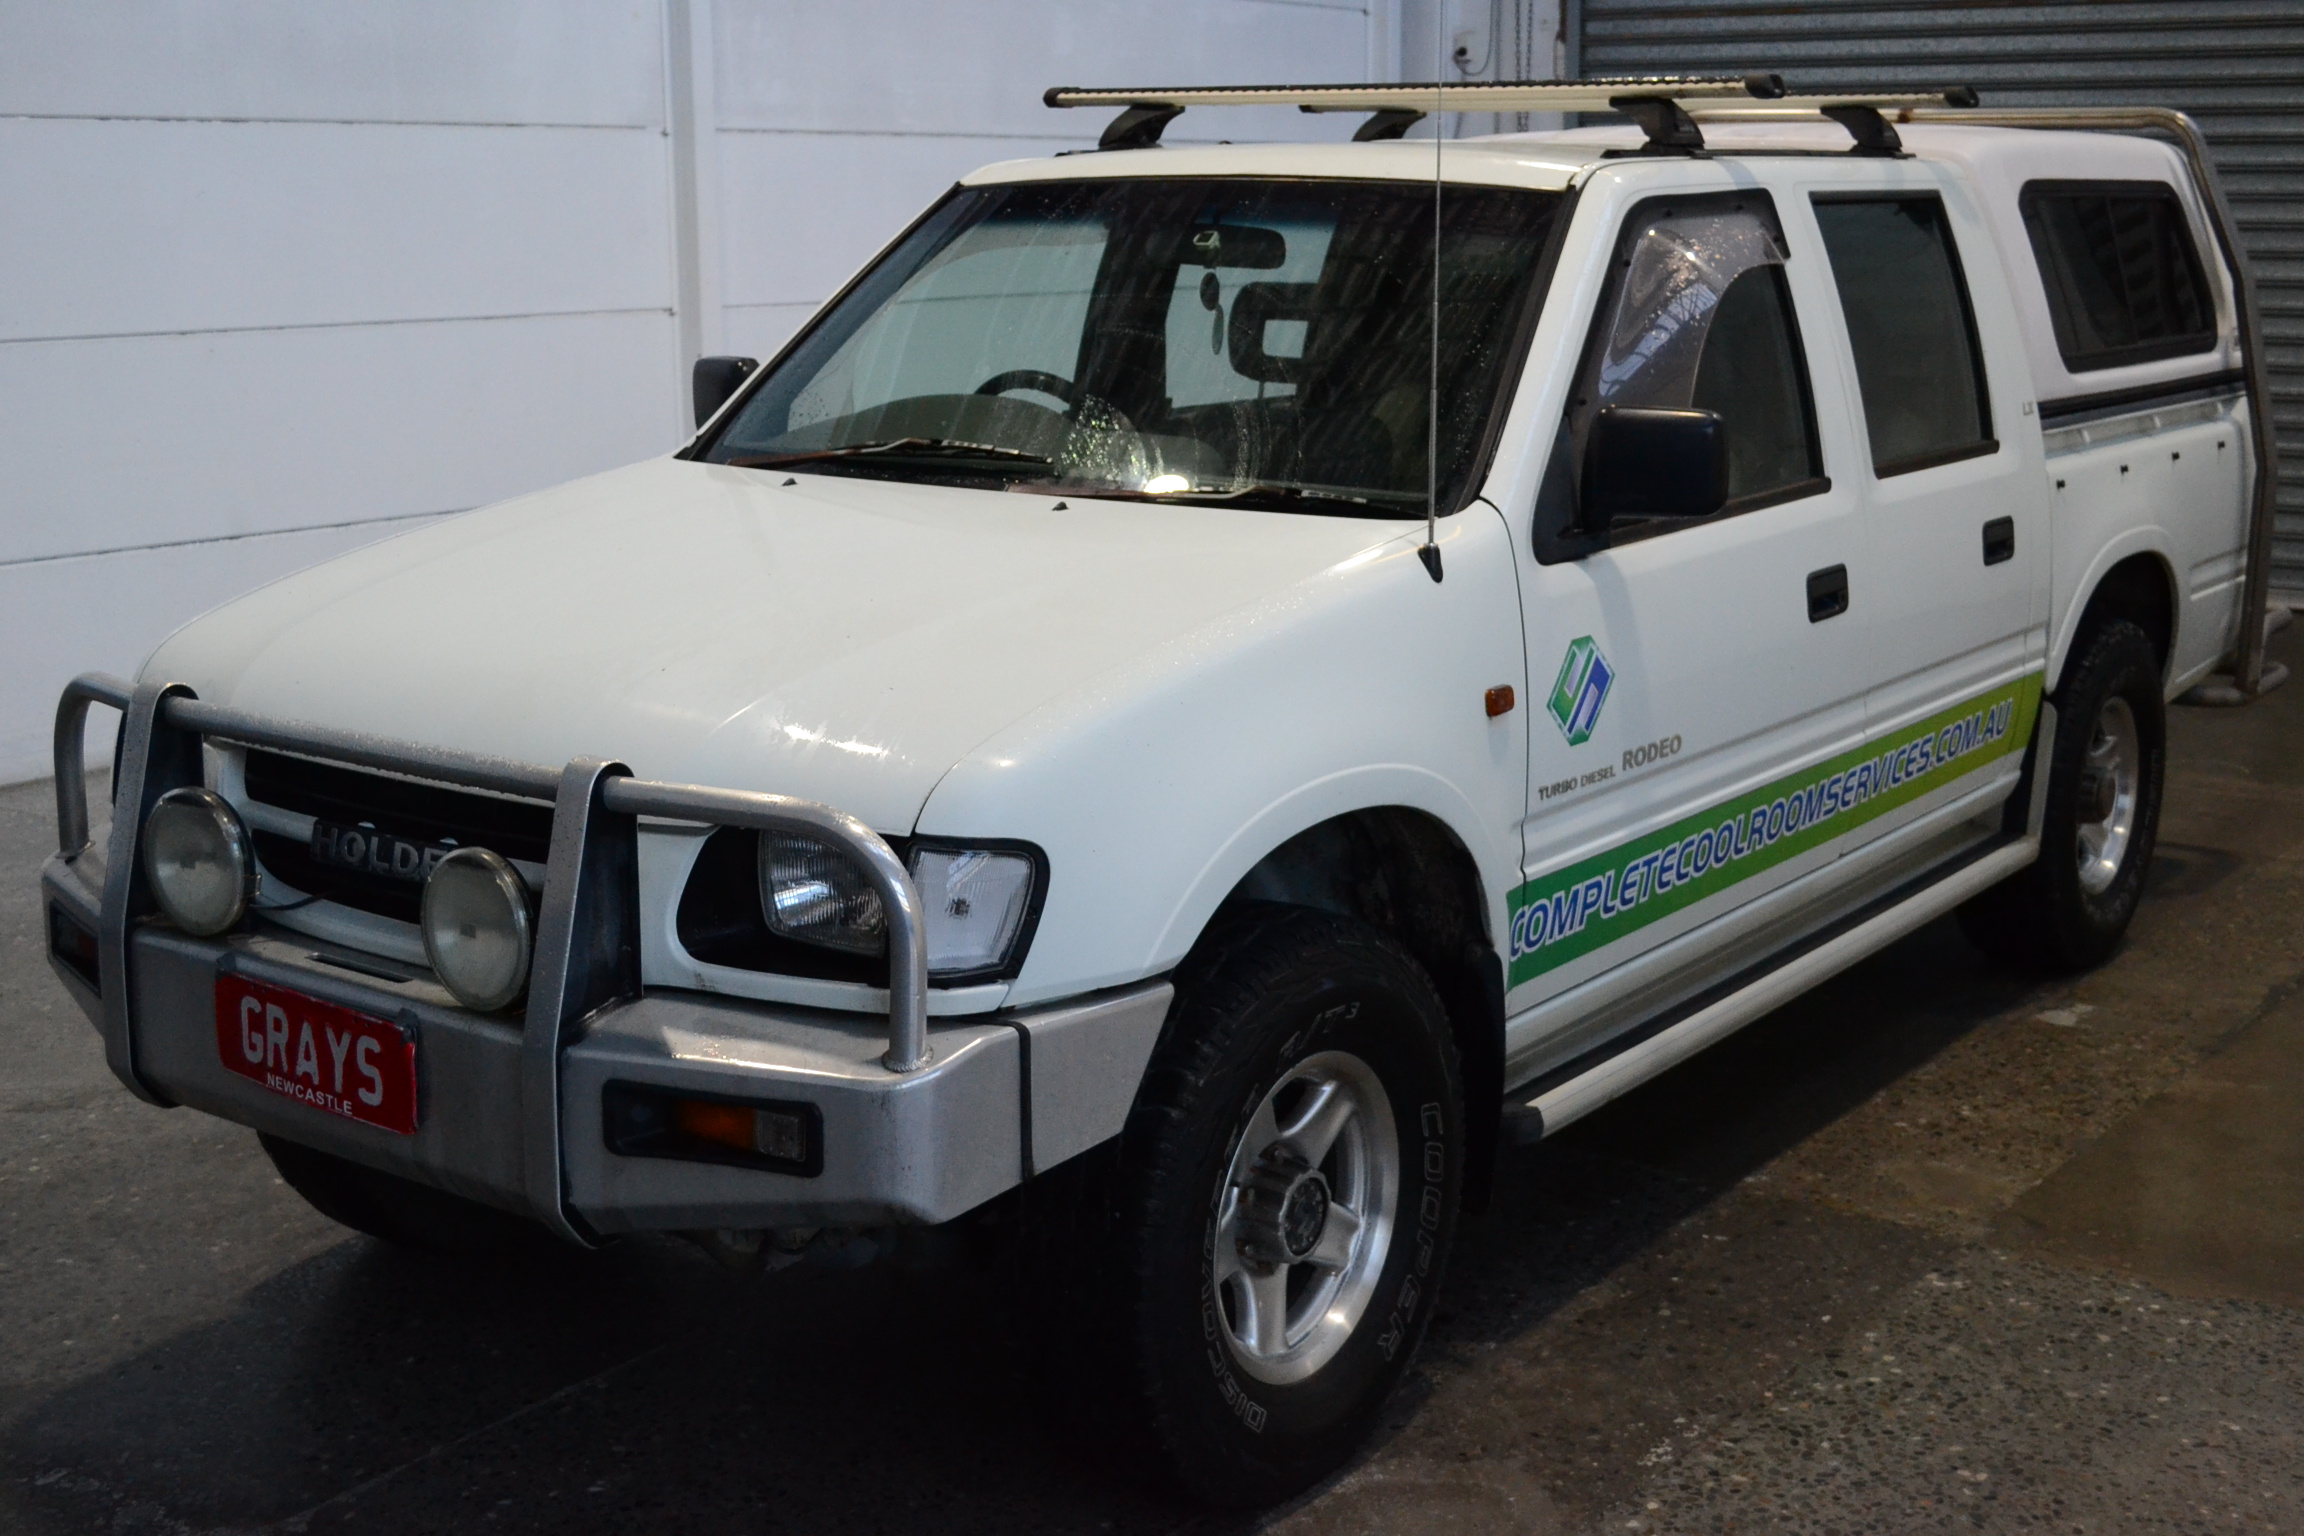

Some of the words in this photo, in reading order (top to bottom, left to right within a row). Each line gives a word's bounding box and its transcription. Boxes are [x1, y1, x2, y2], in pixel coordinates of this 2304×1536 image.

[1538, 777, 1578, 801] TURBO
[1580, 765, 1616, 787] DIESEL
[1622, 733, 1682, 771] RODEO
[312, 824, 448, 877] HOLDE
[1509, 698, 2014, 962] COMPLETECOOLROOMSERVICES.COM.AU
[240, 995, 384, 1107] GRAYS
[266, 1072, 353, 1115] NEWCASTLE
[1376, 1102, 1444, 1363] COOPER
